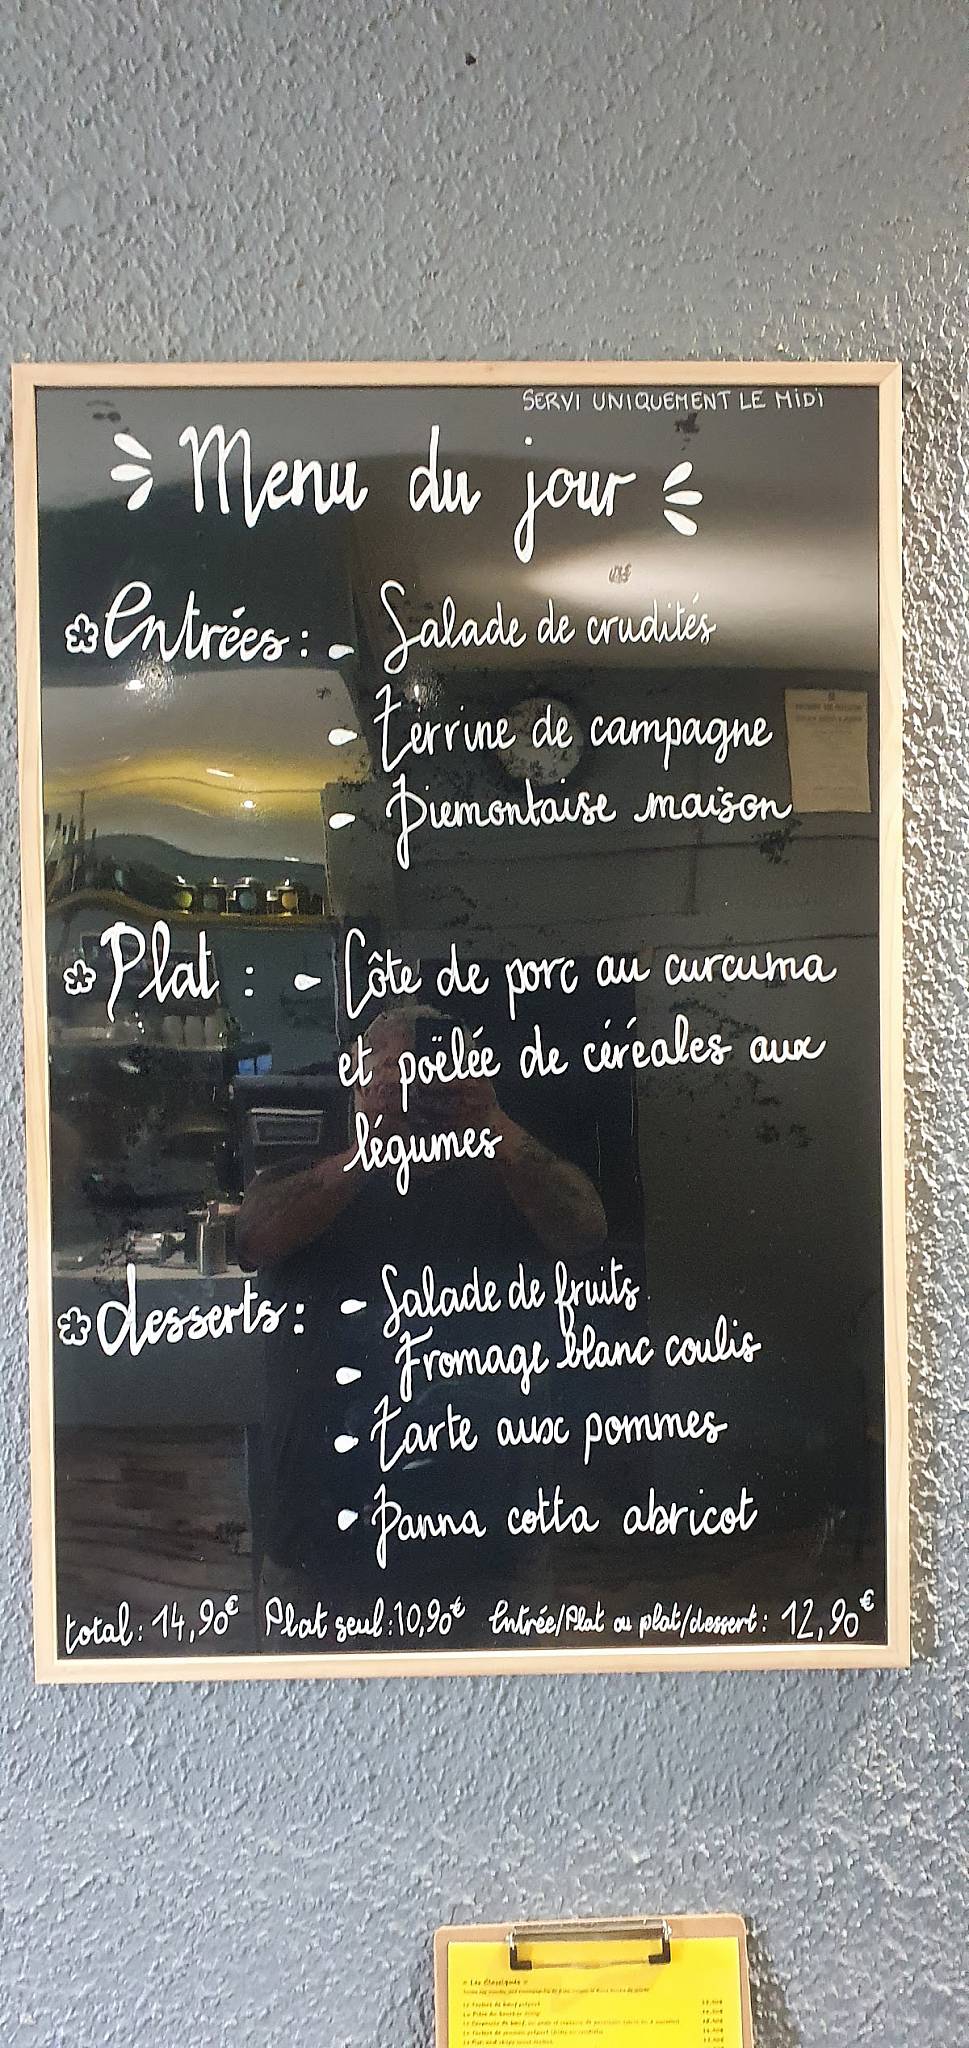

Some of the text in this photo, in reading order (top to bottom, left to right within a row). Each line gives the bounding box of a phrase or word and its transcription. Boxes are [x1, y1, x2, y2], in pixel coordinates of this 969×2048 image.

[523, 388, 581, 411] SERVI
[592, 389, 731, 411] UNIQUEMENT
[739, 390, 767, 409] LE
[179, 425, 637, 563] Menu du jour
[381, 580, 716, 674] Salade de crudités
[532, 704, 573, 749] de
[590, 717, 773, 770] campagne
[633, 786, 793, 824] maison
[101, 921, 221, 1022] Plat
[345, 927, 837, 1020] Côte de porc au curcuma
[338, 1035, 373, 1087] et
[519, 1024, 569, 1079] de
[583, 1014, 733, 1073] céréales
[750, 1034, 827, 1064] aux
[344, 1111, 503, 1195] légumes
[381, 1257, 641, 1338] Salade de fruits
[394, 1314, 762, 1403] Fromage blanc coulis
[497, 1417, 570, 1447] aux
[584, 1411, 728, 1464] pommes
[507, 1486, 600, 1536] cotta
[623, 1487, 758, 1536] abricot
[151, 1594, 240, 1643] 14,90€
[265, 1596, 329, 1639] Plat
[613, 1614, 632, 1633] ou
[781, 1588, 875, 1642] 12,90€
